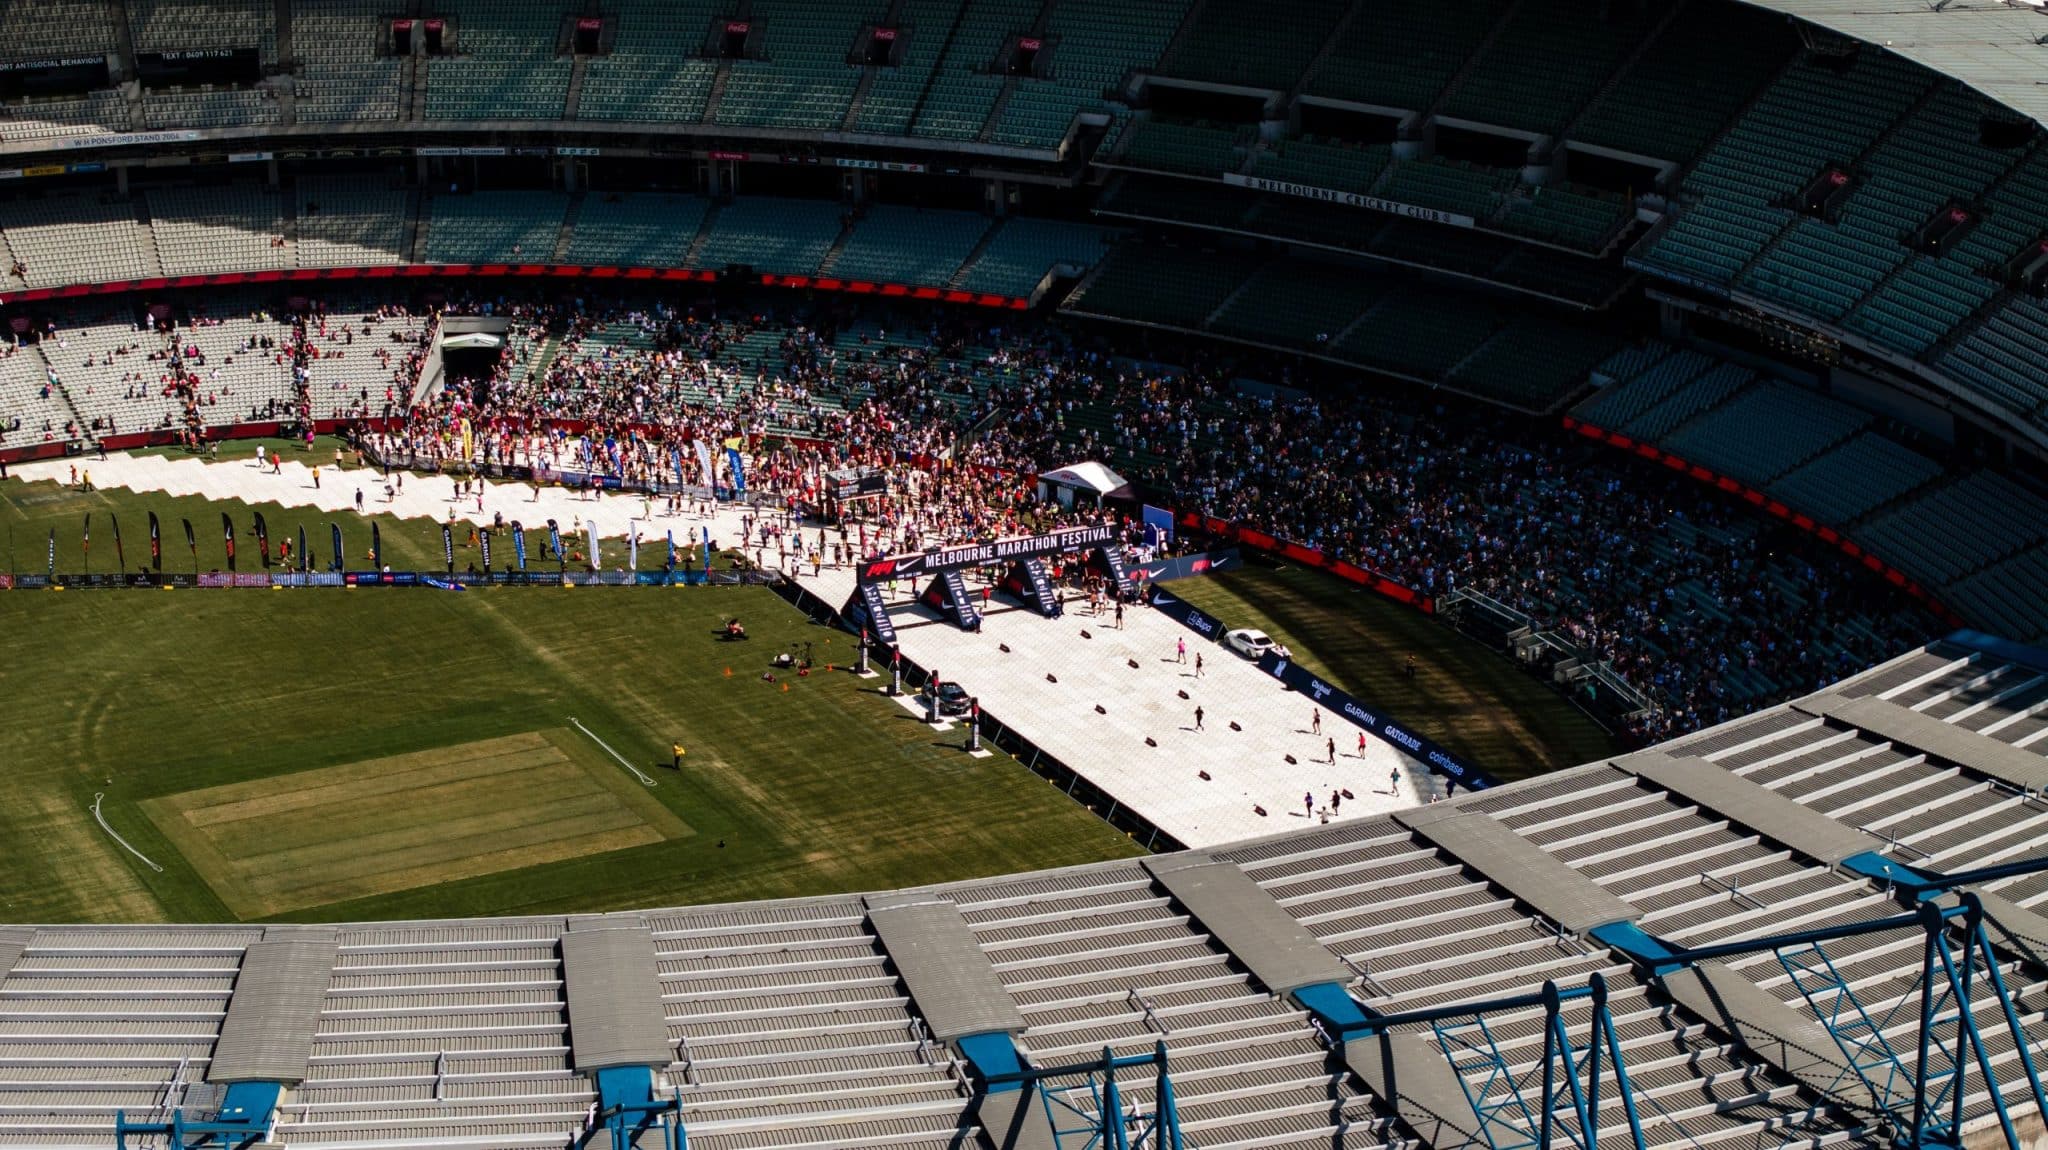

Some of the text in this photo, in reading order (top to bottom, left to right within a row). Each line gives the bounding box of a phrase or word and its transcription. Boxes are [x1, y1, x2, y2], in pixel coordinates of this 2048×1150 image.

[15, 59, 60, 69] ANTISOCIAL
[60, 56, 104, 67] BEHAVIOUR
[162, 52, 180, 60] TEXT
[205, 50, 219, 58] 117
[219, 49, 233, 57] 621
[73, 139, 82, 147] W
[91, 136, 133, 145] PONSFORD
[134, 134, 160, 142] STAND
[1258, 179, 1439, 221] MELBOURNE CRICKET CLUB
[443, 529, 453, 563] GARMIN
[480, 531, 489, 566] GARMIN
[925, 526, 1113, 568] MELBOURNE MARATHON FESTIVAL
[1195, 617, 1213, 633] Bupa
[1344, 702, 1376, 726] GARMIN
[1384, 725, 1422, 751] GATORADE
[1428, 751, 1464, 776] coinbase
